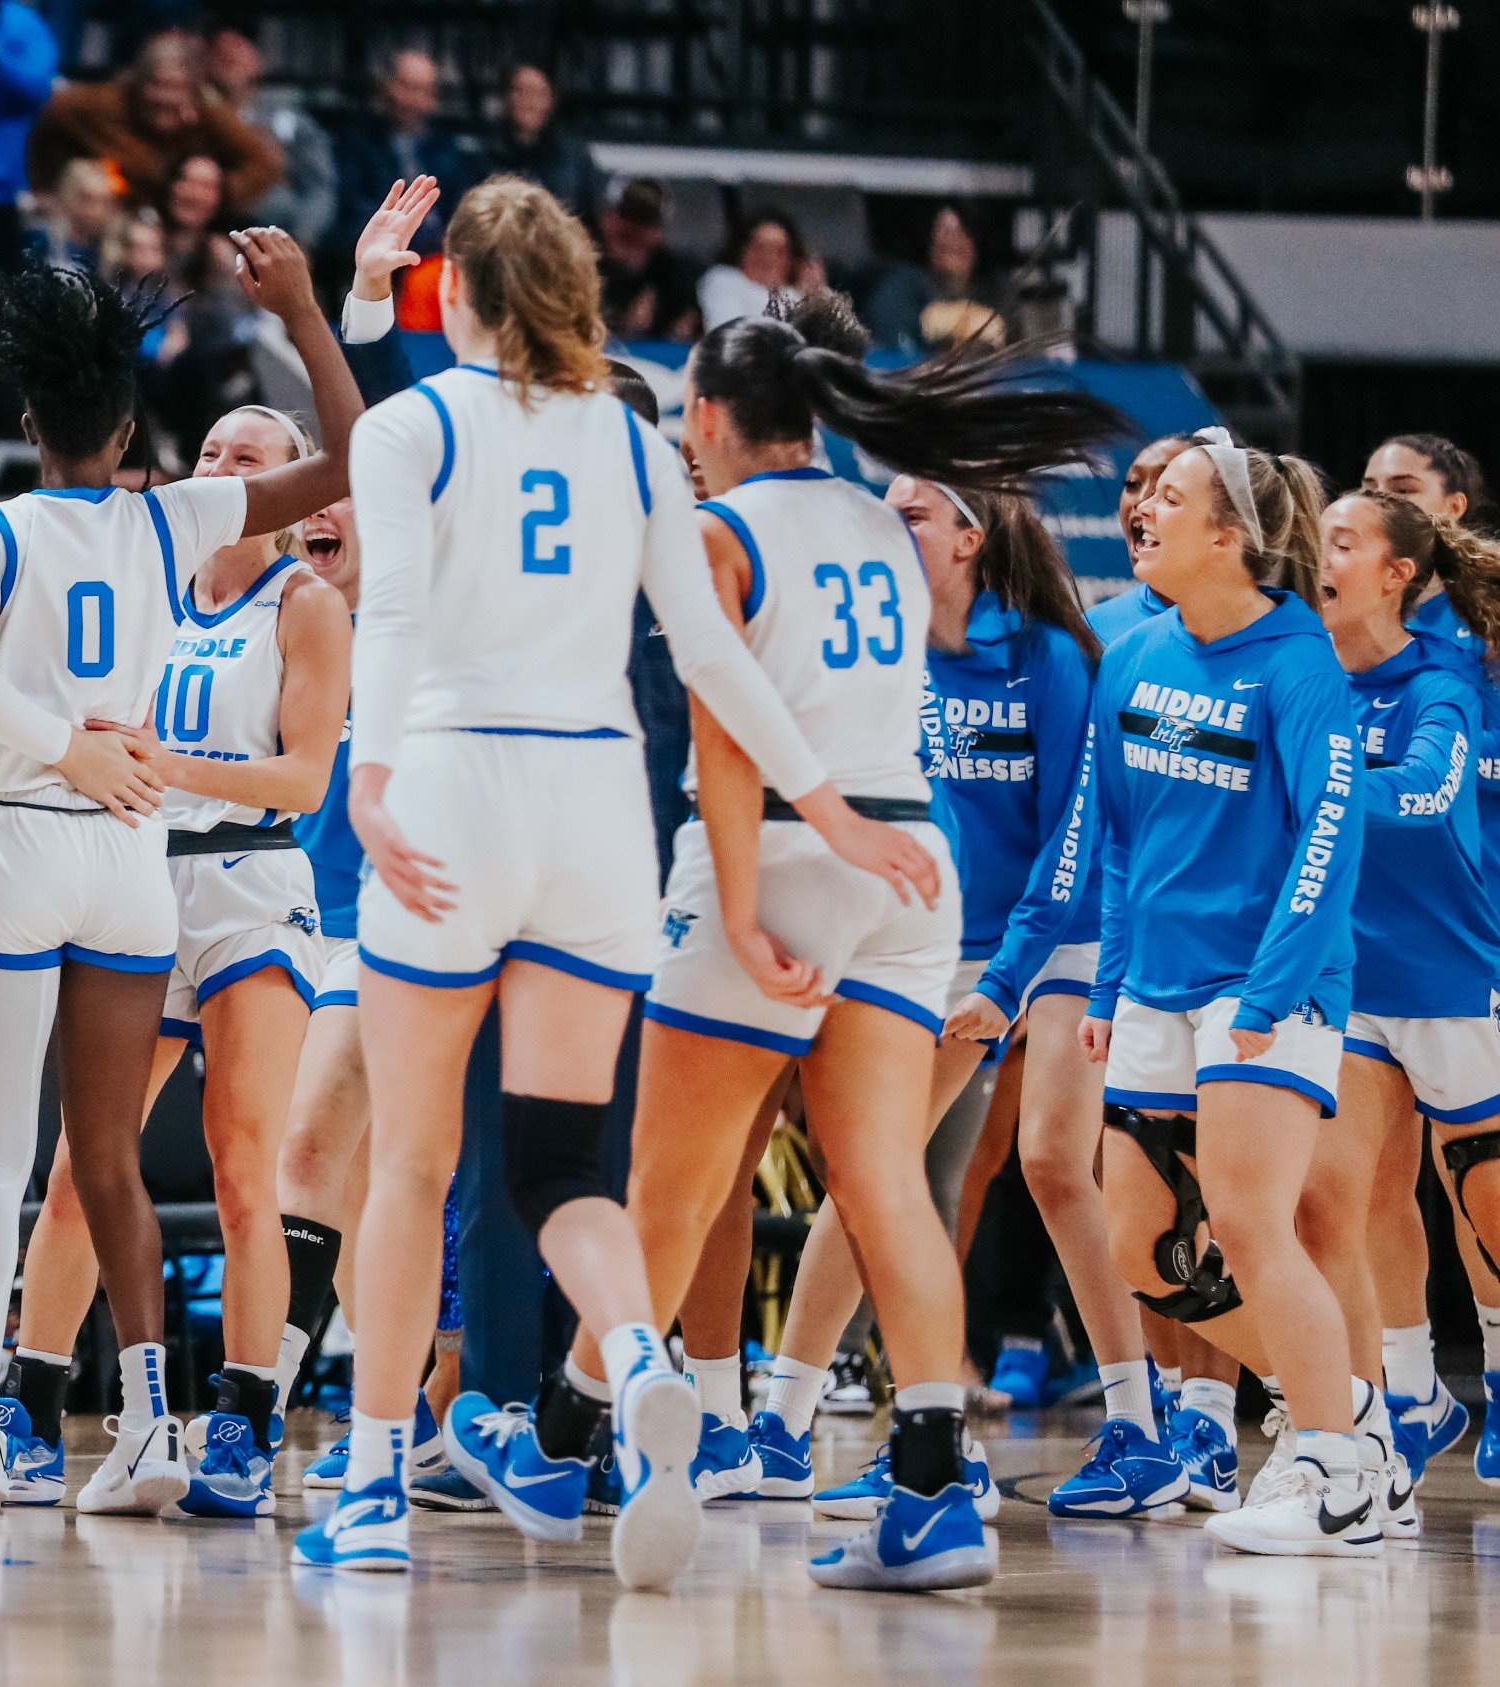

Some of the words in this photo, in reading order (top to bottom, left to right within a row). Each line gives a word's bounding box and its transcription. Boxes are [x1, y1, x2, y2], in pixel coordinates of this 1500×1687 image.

[521, 469, 570, 574] 2
[67, 581, 114, 677] 0
[813, 561, 903, 669] 33
[169, 638, 247, 658] IDDLE
[155, 664, 214, 743] 10
[939, 697, 1027, 728] DDLE
[1130, 681, 1248, 732] MIDDLE
[1150, 715, 1197, 752] MT
[939, 755, 1035, 782] NESSEE
[1326, 733, 1353, 798] BLUE
[1051, 794, 1084, 904] RAIDERS
[1290, 800, 1346, 916] RAIDERS
[282, 1228, 325, 1245] ueller.
